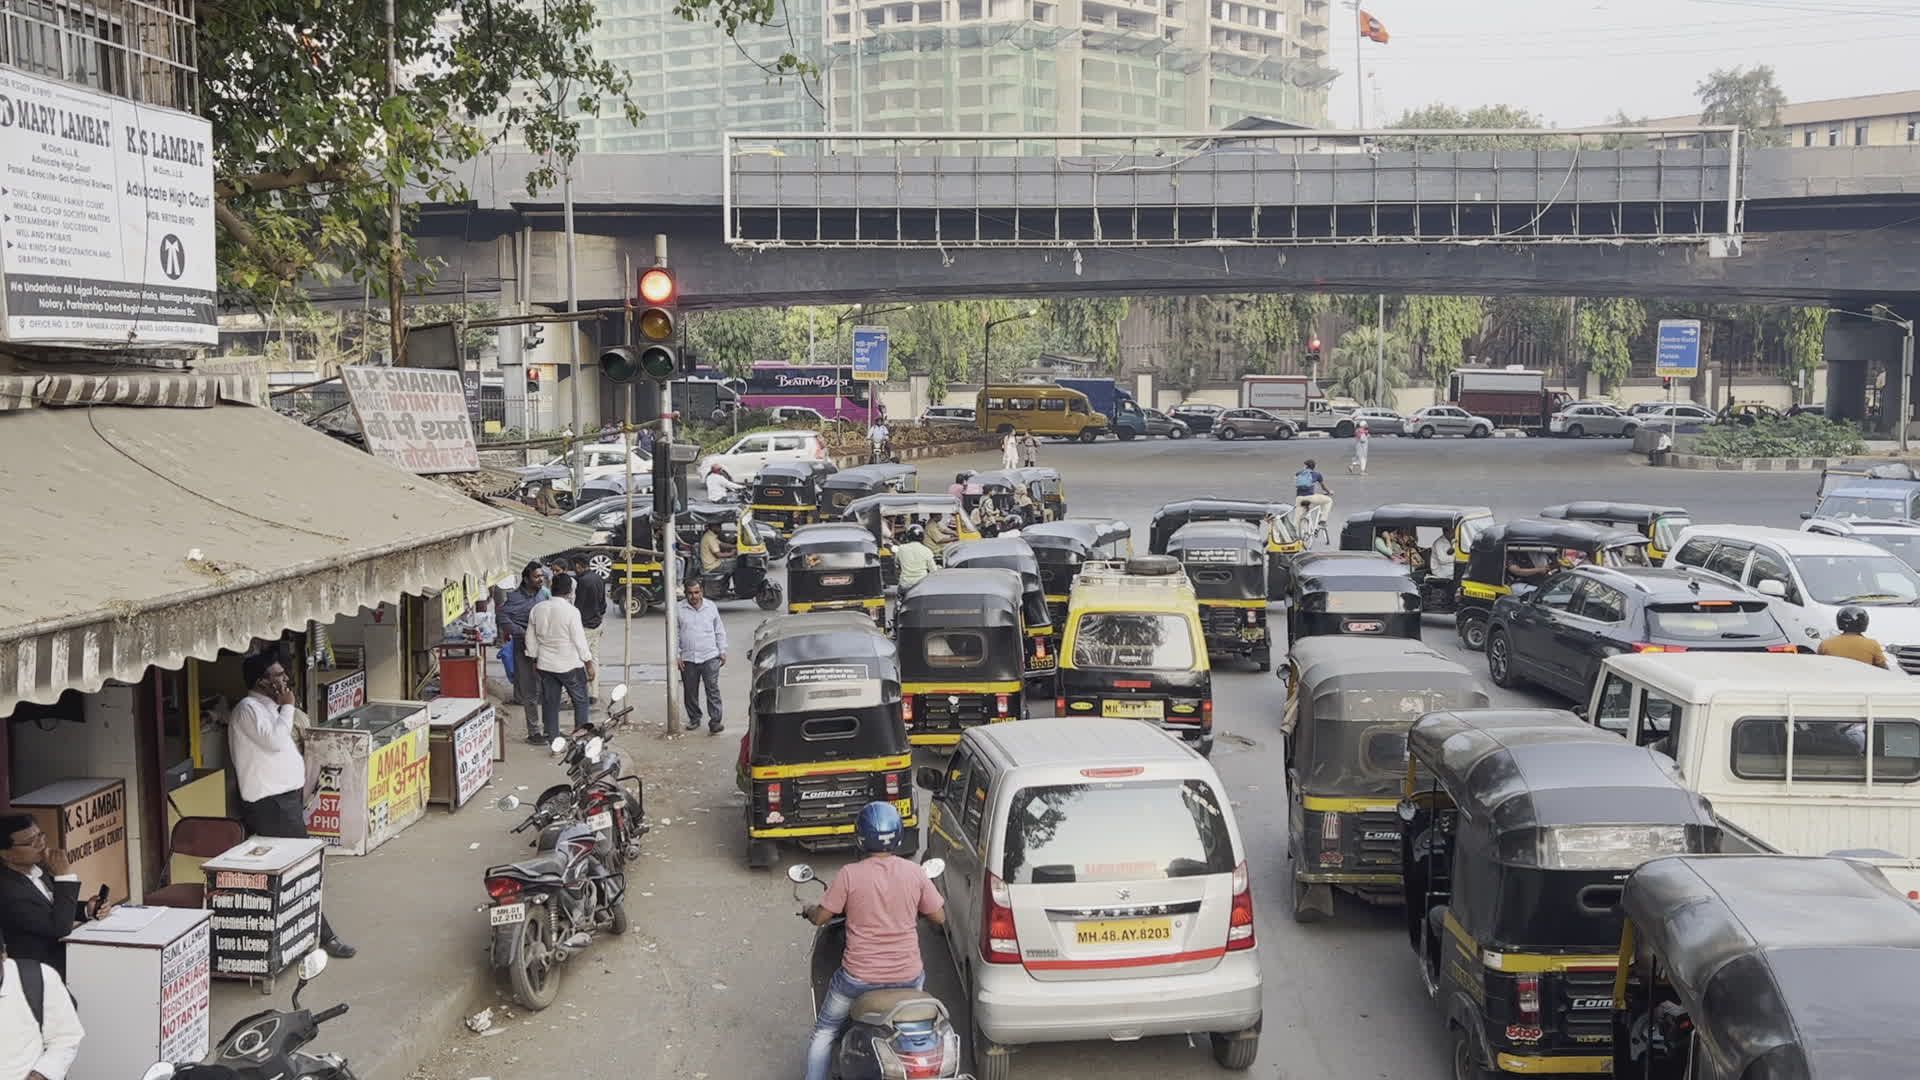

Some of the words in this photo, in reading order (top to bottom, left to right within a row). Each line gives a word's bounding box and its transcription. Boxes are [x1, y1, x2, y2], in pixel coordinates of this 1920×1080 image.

[16, 98, 56, 136] MARY
[59, 109, 110, 148] LAMBAT
[152, 131, 205, 167] LAMBAT
[126, 180, 168, 202] Advocate
[168, 187, 188, 208] High
[188, 191, 210, 208] Court
[10, 281, 23, 292] We
[24, 281, 62, 294] Undertake
[63, 284, 73, 295] All
[73, 285, 93, 297] Legal
[93, 286, 140, 300] Documentation
[39, 298, 66, 311] Notary,
[66, 299, 103, 312] Partnership
[104, 302, 122, 313] Deed
[384, 371, 464, 394] SHARMA
[420, 414, 470, 441] शर्मा
[457, 724, 493, 758] NOTARY
[376, 741, 408, 782] AMAR
[393, 755, 428, 796] अमर
[84, 788, 123, 825] LAMBAT
[212, 894, 234, 909] Power
[242, 894, 272, 913] Attorney
[163, 948, 181, 965] SUNIL
[216, 934, 236, 951] Leave
[242, 935, 269, 953] License
[217, 955, 269, 974] Agreements
[163, 959, 209, 1003] MARRIAGE
[162, 976, 208, 1022] REGISTRATION
[162, 1002, 199, 1041] NOTARY
